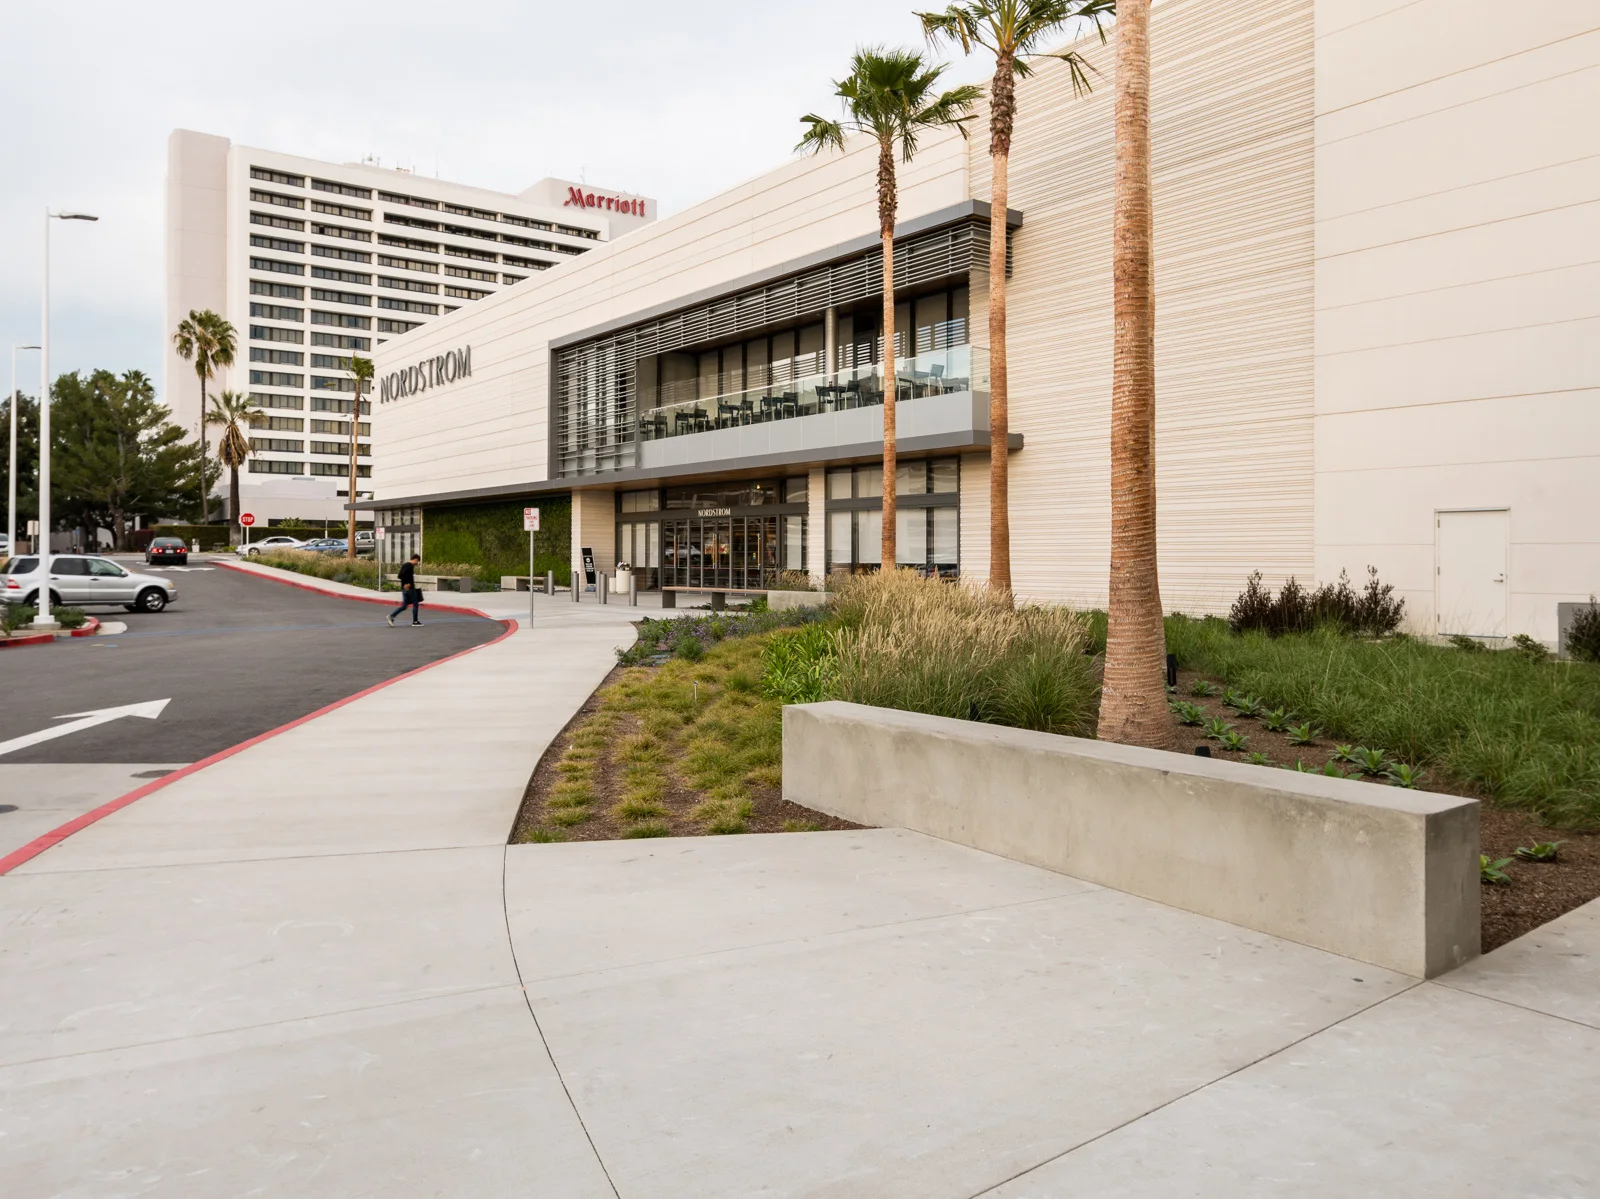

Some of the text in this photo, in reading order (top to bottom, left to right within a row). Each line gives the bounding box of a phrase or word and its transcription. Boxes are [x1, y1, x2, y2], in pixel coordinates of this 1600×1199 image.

[563, 186, 645, 217] Marriott
[380, 344, 472, 404] NORDSTROM
[697, 507, 731, 517] NORDSTROM
